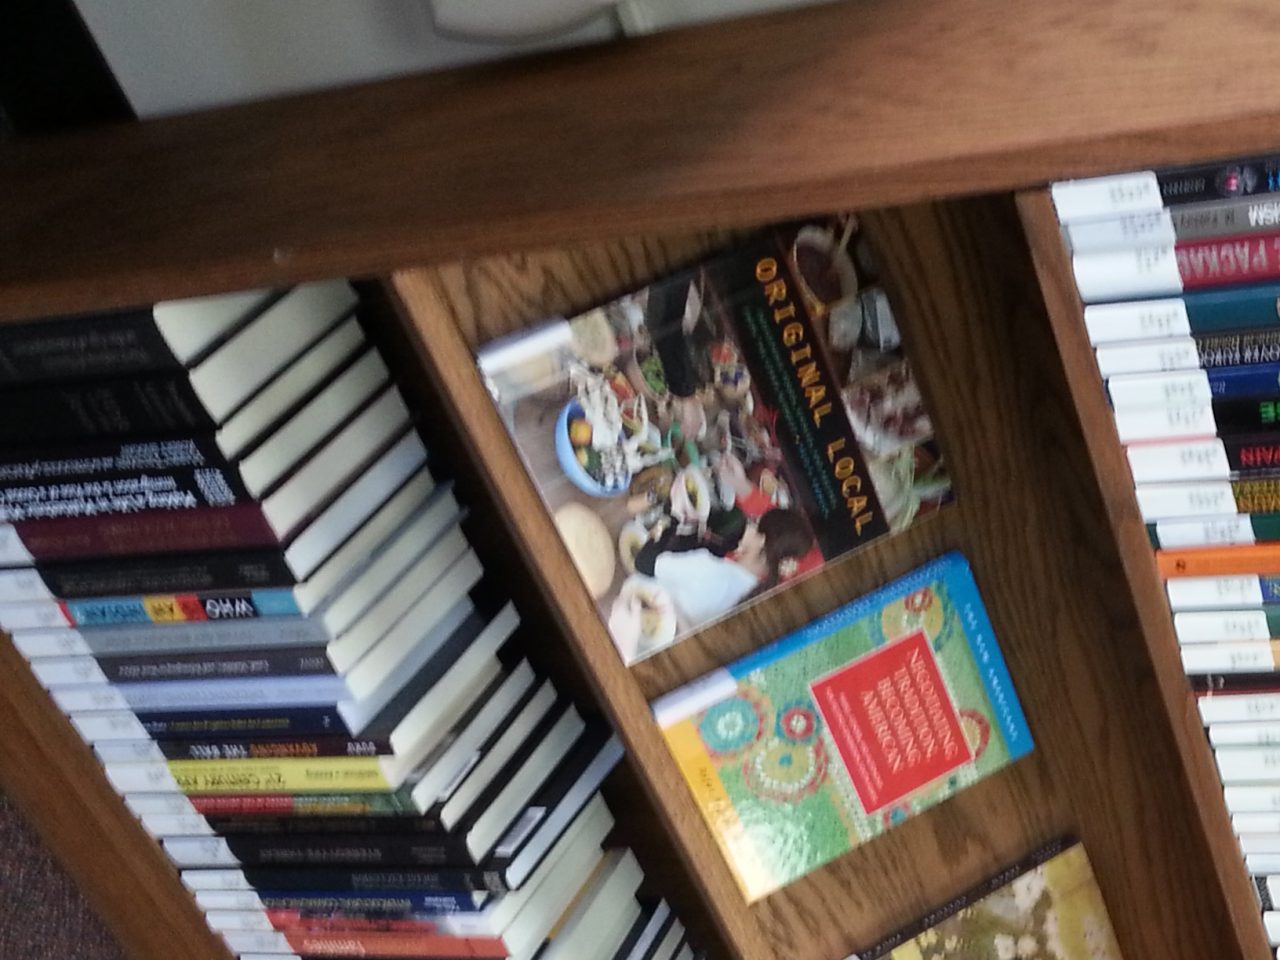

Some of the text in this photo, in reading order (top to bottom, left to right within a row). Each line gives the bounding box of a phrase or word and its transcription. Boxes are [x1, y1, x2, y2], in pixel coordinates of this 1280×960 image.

[1243, 343, 1279, 364] OVER
[755, 257, 833, 429] ORIGINAL
[826, 437, 874, 537] LOCAL
[205, 597, 254, 619] WHO
[861, 690, 904, 774] AMERICAN
[876, 676, 921, 768] BECOMING
[909, 647, 959, 761] NEGOTIATING
[222, 743, 247, 758] THE
